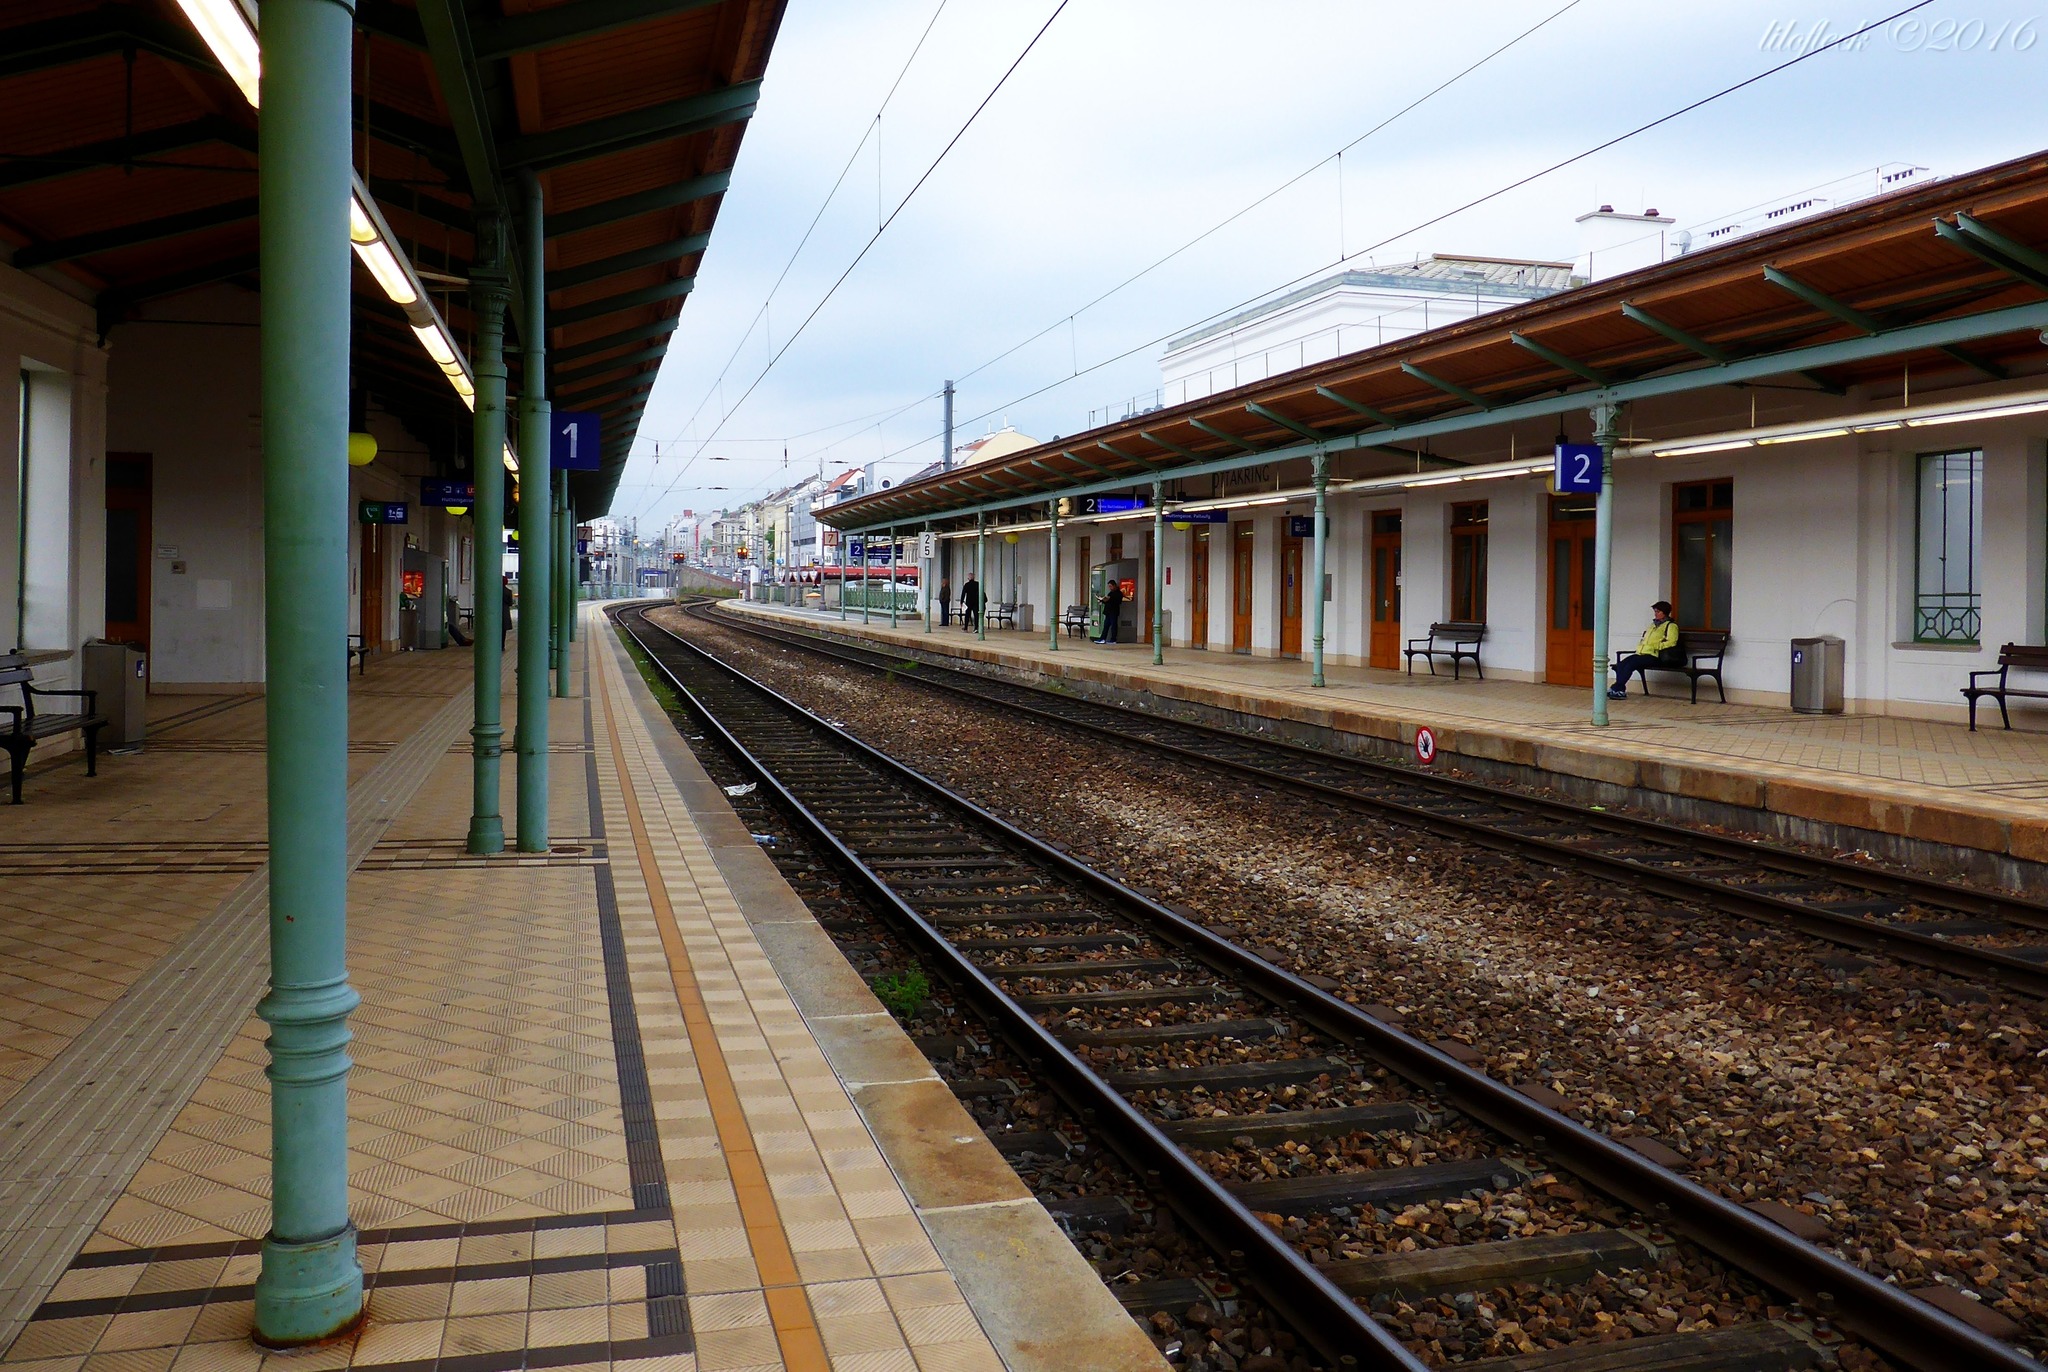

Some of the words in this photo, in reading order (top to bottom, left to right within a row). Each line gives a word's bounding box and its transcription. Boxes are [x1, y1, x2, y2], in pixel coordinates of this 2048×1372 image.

[562, 422, 578, 459] 1
[1574, 454, 1590, 483] 2
[1086, 498, 1095, 512] 2
[581, 528, 588, 539] 7
[828, 534, 834, 543] 7
[924, 534, 930, 544] 2
[854, 545, 861, 555] 2
[924, 545, 930, 556] 5
